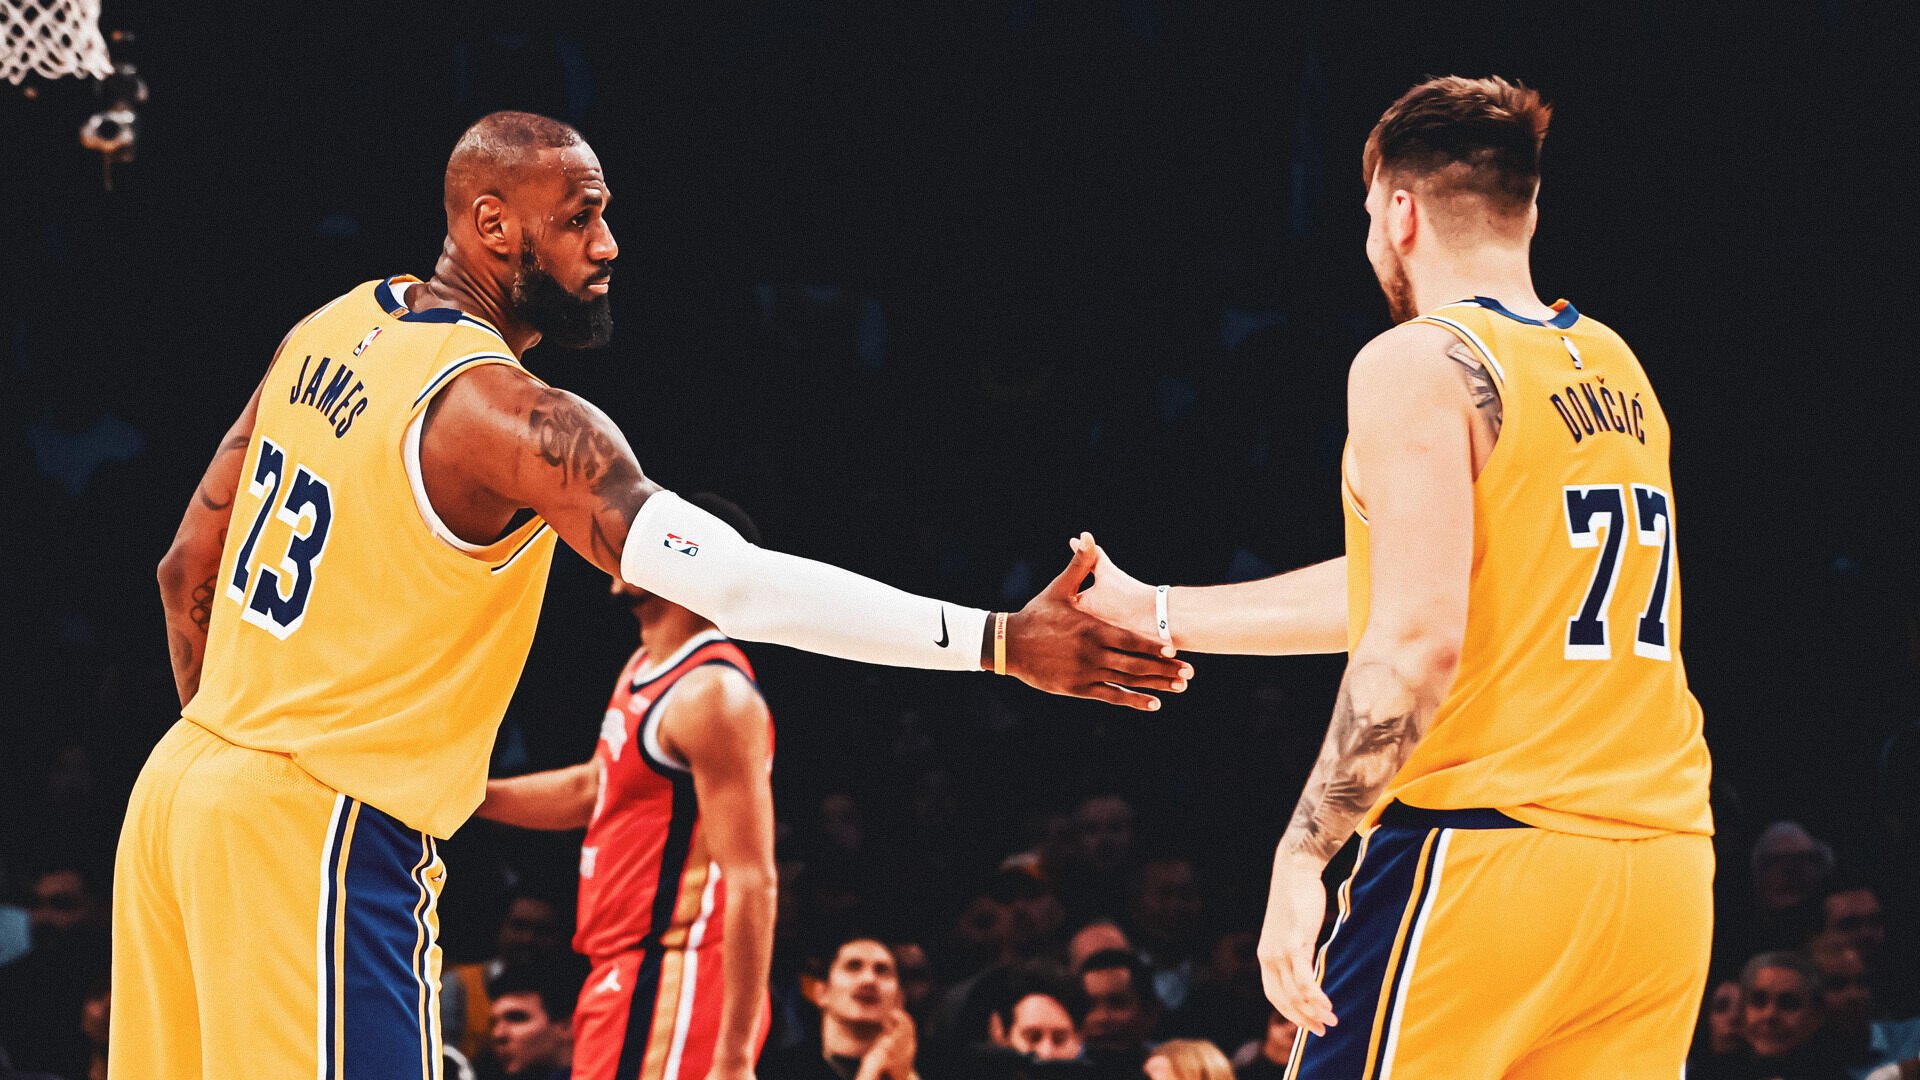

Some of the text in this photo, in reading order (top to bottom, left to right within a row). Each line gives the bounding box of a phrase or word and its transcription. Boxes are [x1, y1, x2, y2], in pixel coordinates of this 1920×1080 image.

[289, 355, 368, 438] JAMES
[1550, 375, 1646, 445] DONČIĆ
[1562, 482, 1674, 661] 77
